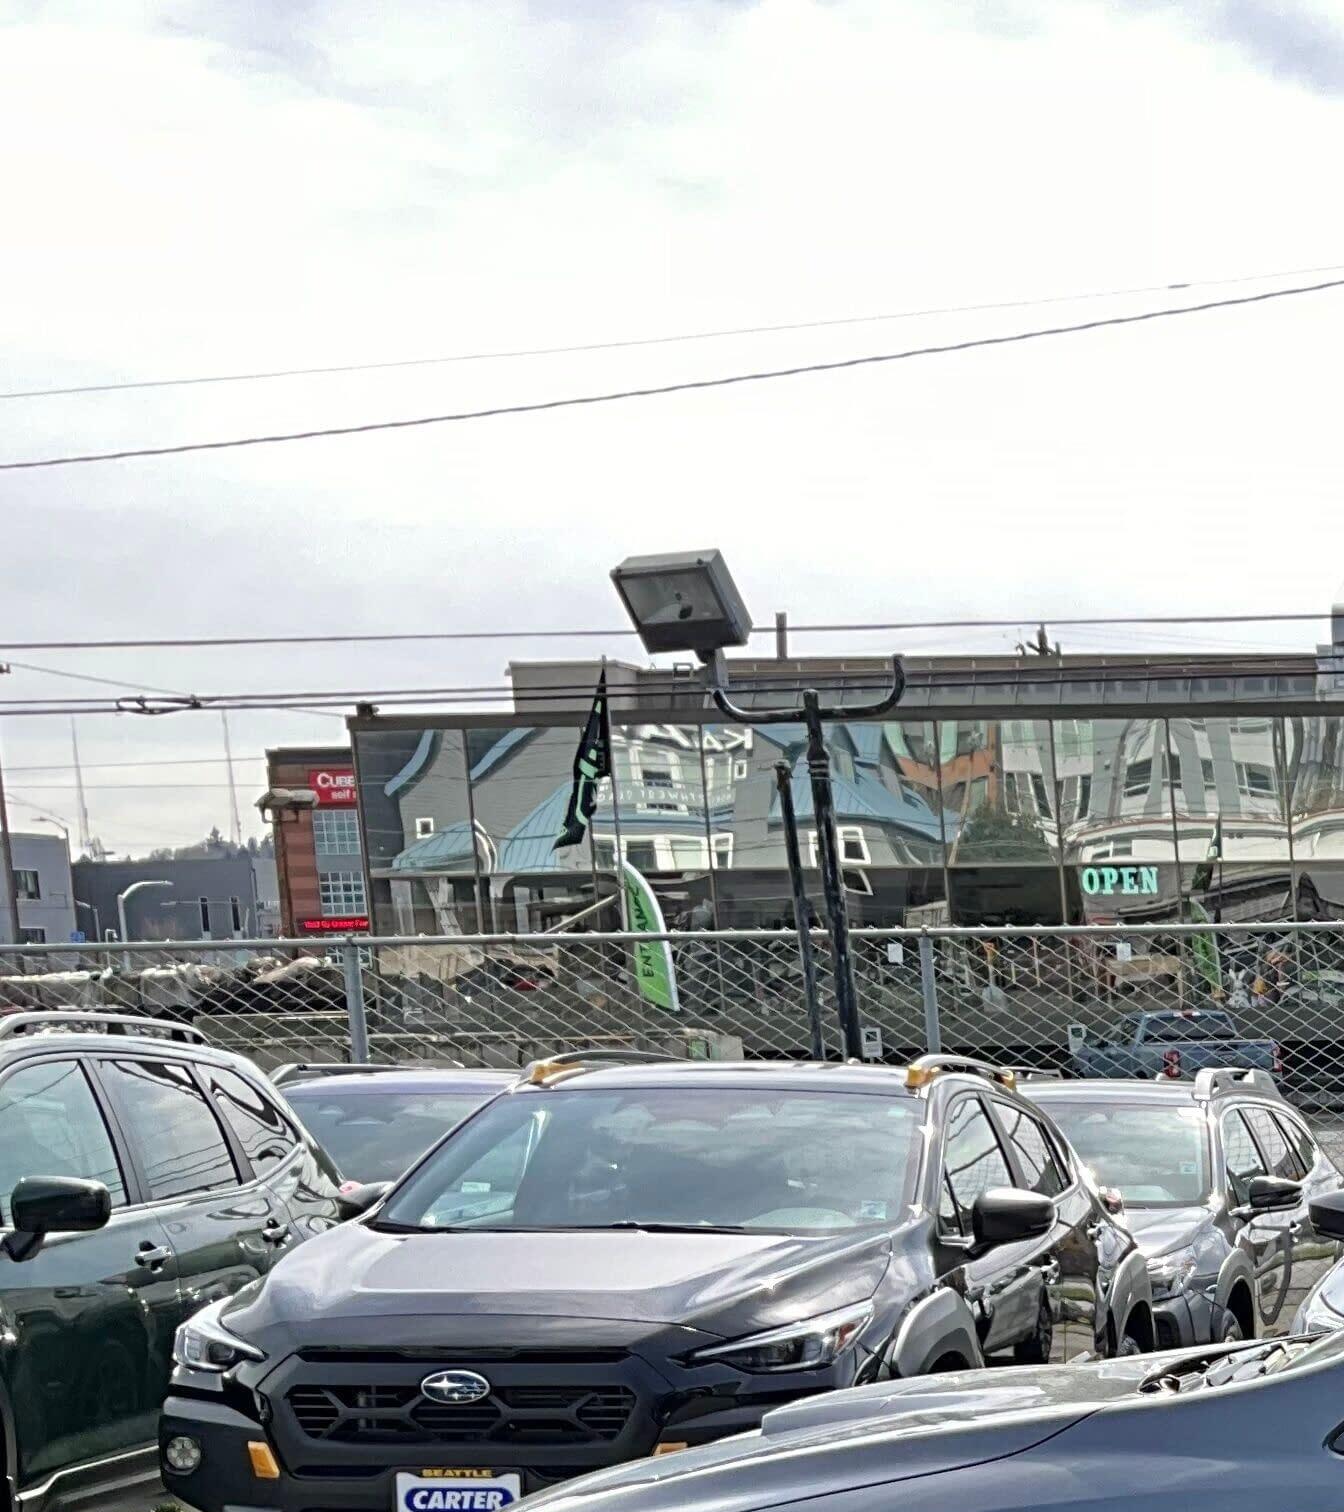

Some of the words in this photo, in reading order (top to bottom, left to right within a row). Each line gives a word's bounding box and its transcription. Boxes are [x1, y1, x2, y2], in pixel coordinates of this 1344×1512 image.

[1082, 867, 1159, 895] OPEN
[628, 882, 654, 978] ENTANCE
[422, 1469, 492, 1478] SEATTLE
[413, 1491, 503, 1510] CARTER
